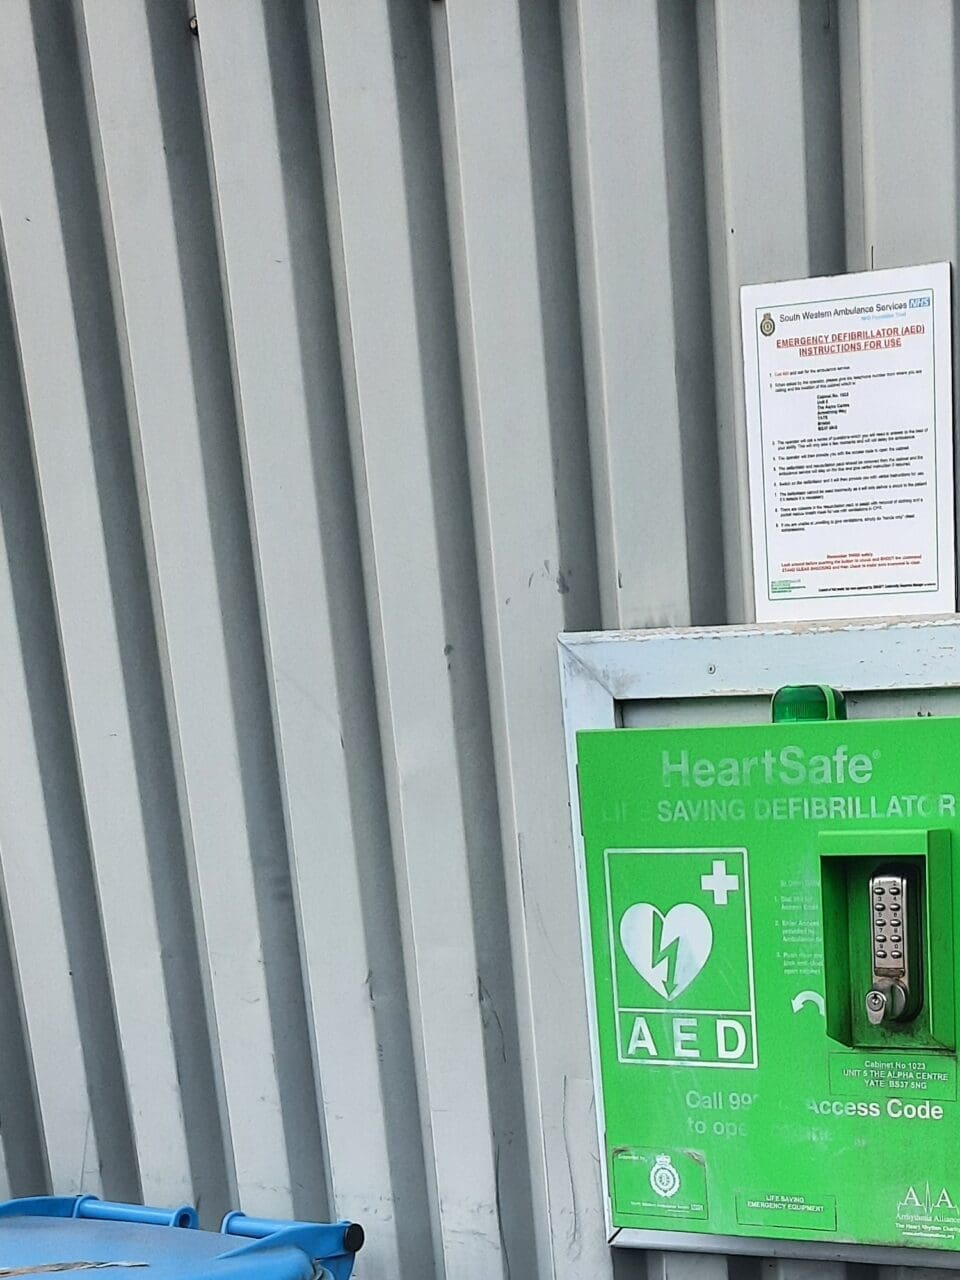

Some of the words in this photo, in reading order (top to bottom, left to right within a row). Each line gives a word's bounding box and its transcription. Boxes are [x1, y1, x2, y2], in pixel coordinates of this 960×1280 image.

[779, 313, 801, 323] South
[802, 311, 832, 320] Western
[833, 306, 874, 317] Ambulance
[876, 302, 907, 313] Services
[909, 297, 930, 308] NHS
[776, 334, 829, 349] EMERGENCY
[830, 327, 900, 342] DEFIBRILLATOR
[900, 324, 926, 336] (AED)
[799, 343, 862, 358] INSTRUCTIONS
[863, 340, 881, 350] FOR
[883, 337, 902, 348] USE
[656, 799, 746, 823] SAVING
[842, 1069, 862, 1077] UNIT
[869, 1070, 886, 1078] THE
[886, 1071, 914, 1079] ALPHA
[915, 1072, 949, 1081] CENTRE
[864, 1060, 894, 1069] Cabinet
[895, 1061, 906, 1070] No
[908, 1062, 926, 1071] 1023
[864, 1079, 885, 1088] YATE
[889, 1080, 909, 1089] BS37
[685, 1090, 724, 1110] Call
[807, 1098, 882, 1118] Access
[886, 1098, 945, 1120] Code
[687, 1117, 706, 1134] to
[747, 1200, 786, 1210] EMERGENCY
[787, 1203, 824, 1212] EQUIPMENT
